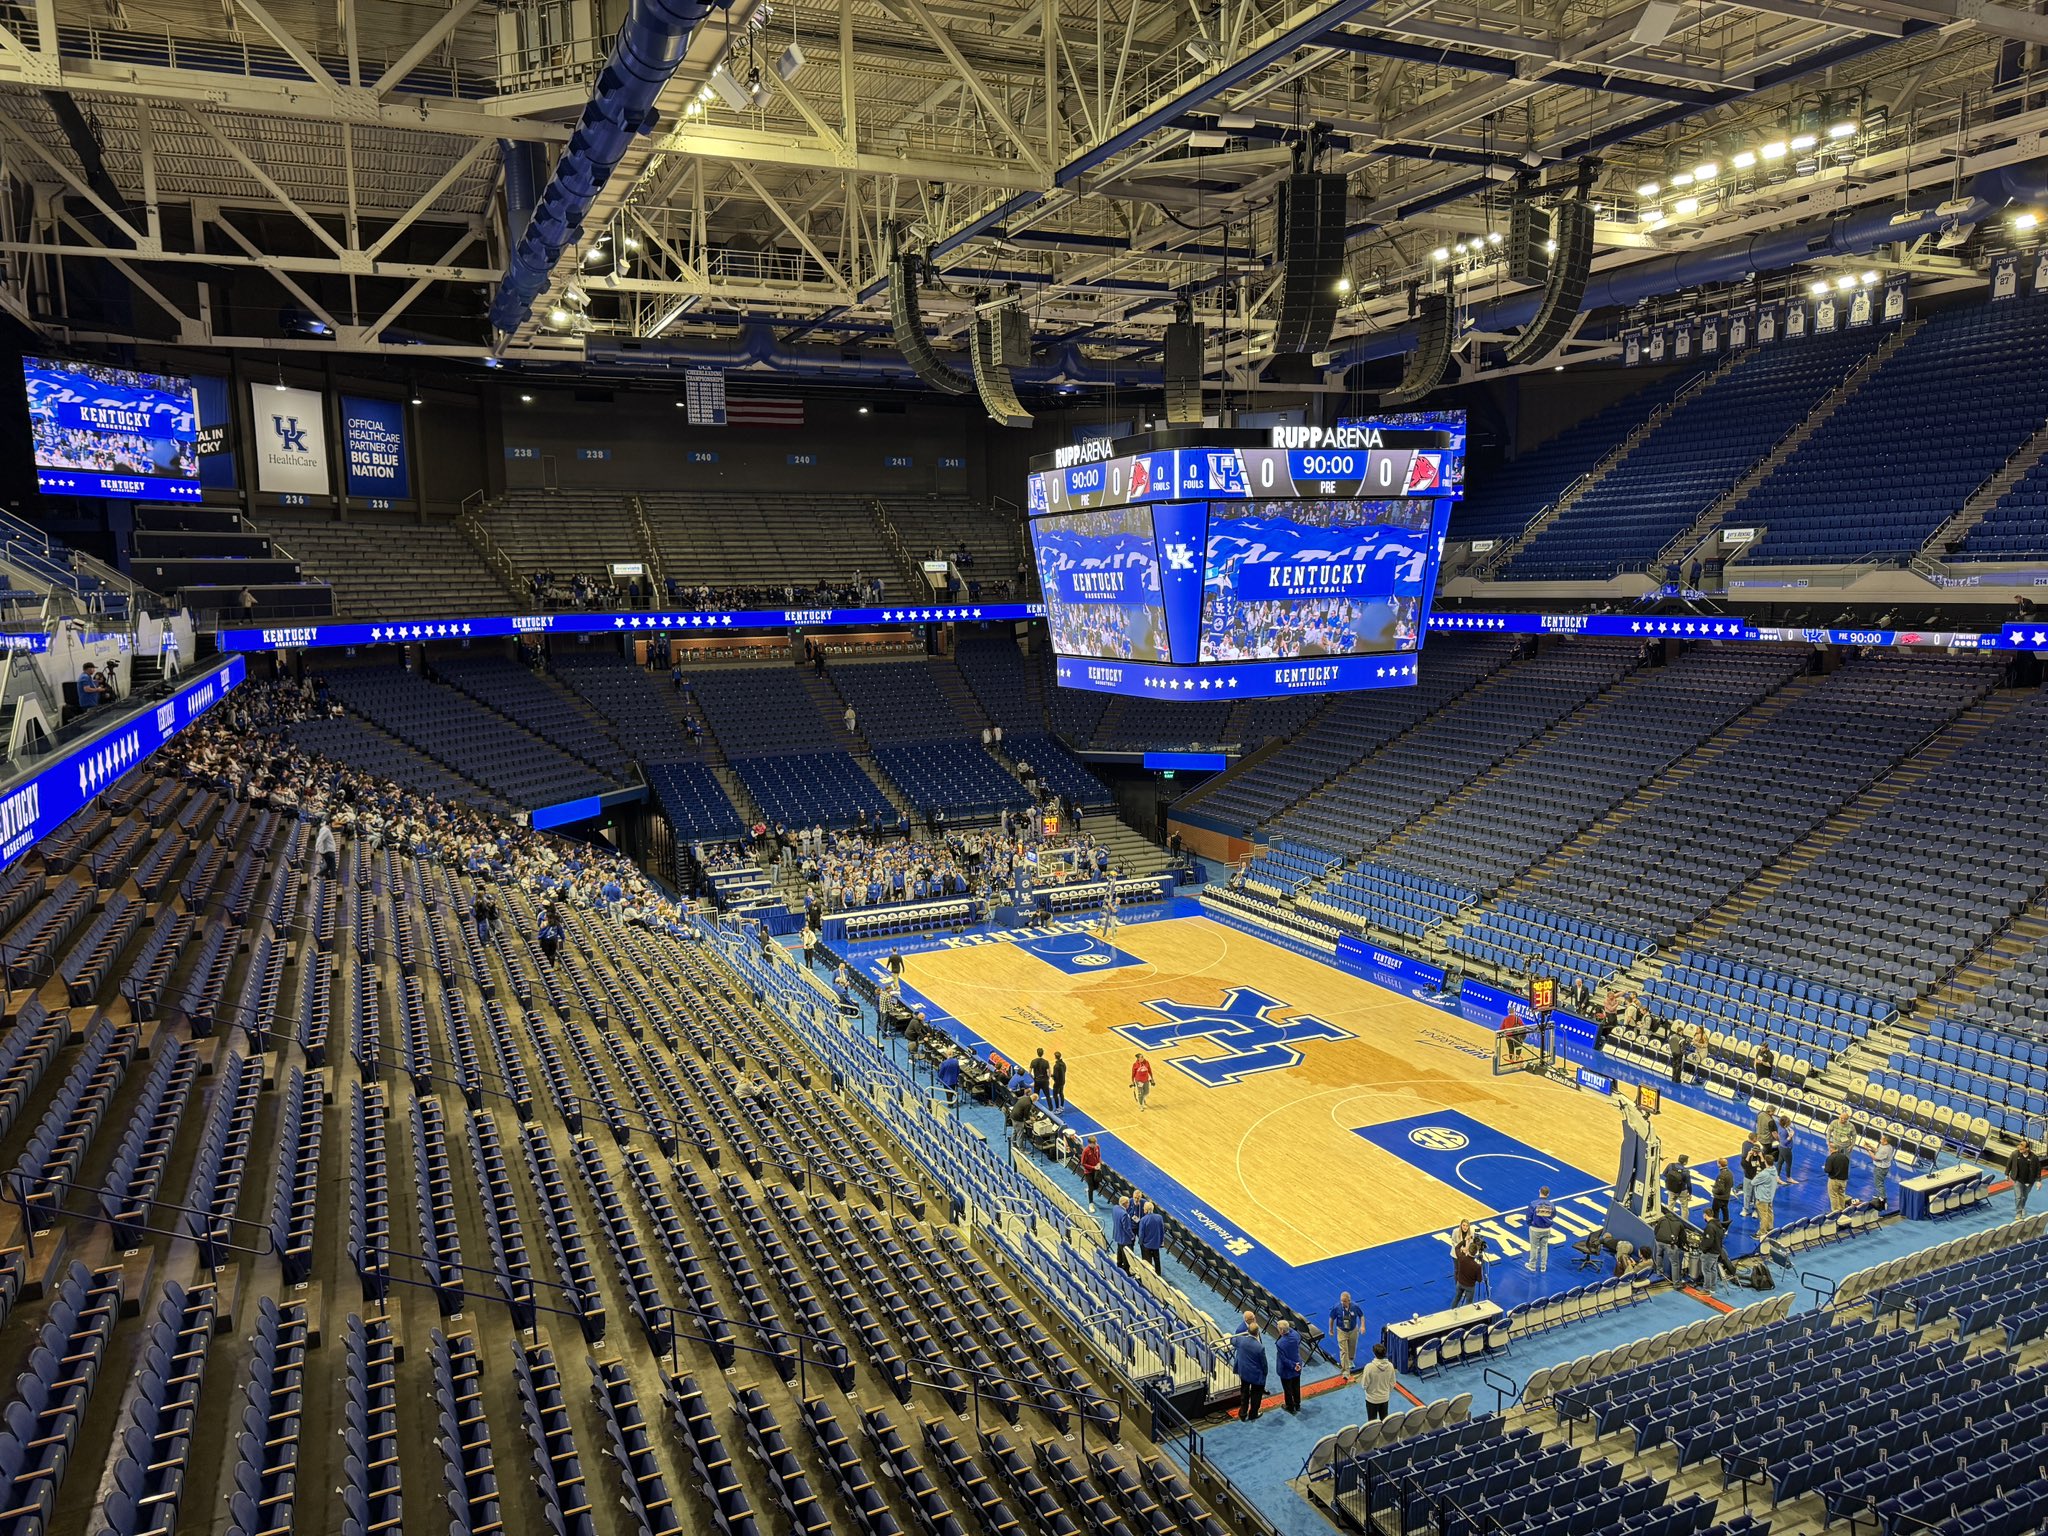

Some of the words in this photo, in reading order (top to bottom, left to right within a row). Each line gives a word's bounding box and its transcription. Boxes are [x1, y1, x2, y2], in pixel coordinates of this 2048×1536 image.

[1996, 256, 2018, 266] JONES
[2000, 277, 2009, 285] 27
[80, 406, 151, 428] KENTUCKY
[97, 423, 139, 432] BASKETBALL
[348, 418, 385, 431] OFFICIAL
[212, 429, 224, 440] IN
[272, 414, 309, 453] UK
[350, 430, 400, 443] HEALTHCARE
[1273, 426, 1323, 448] RUPP
[1322, 427, 1384, 448] ARENA
[350, 440, 386, 452] PARTNER
[387, 444, 399, 453] OF
[514, 448, 532, 457] 238
[351, 452, 370, 464] BIG
[372, 454, 399, 466] BLUE
[586, 450, 604, 459] 238
[695, 453, 712, 461] 240
[795, 456, 810, 464] 240
[1055, 445, 1080, 468] RUPP
[1080, 439, 1113, 463] ARENA
[269, 454, 318, 467] HealthCare
[892, 458, 906, 466] 241
[945, 459, 959, 467] 241
[1303, 455, 1354, 474] 90:00
[352, 465, 395, 478] NATION
[1157, 466, 1164, 480] 0
[1190, 464, 1197, 479] 0
[1261, 458, 1274, 488] 0
[1379, 458, 1392, 487] 0
[100, 479, 145, 490] KENTUCKY
[1072, 468, 1099, 489] 90:00
[1112, 467, 1120, 496] 0
[1183, 480, 1204, 489] FOULS
[1052, 477, 1059, 504] 0
[1153, 481, 1170, 491] FOULS
[1320, 481, 1336, 494] PRE
[286, 495, 304, 504] 236
[372, 500, 389, 509] 236
[1081, 494, 1090, 506] PRE
[1165, 543, 1194, 570] UK
[1072, 571, 1125, 592] KENTUCKY
[1269, 564, 1366, 587] KENTUCKY
[1288, 586, 1346, 595] BASKETBALL
[784, 610, 833, 621] KENTUCKY
[512, 617, 554, 628] KENTUCKY
[1541, 616, 1588, 630] KENTUCKY
[263, 628, 318, 643] KENTUCKY
[1788, 630, 1793, 640] 0
[1850, 632, 1882, 644] 90:00
[1934, 634, 1940, 645] 0
[1088, 666, 1123, 683] KENTUCKY
[1275, 666, 1340, 684] KENTUCKY
[1288, 680, 1327, 688] BASKETBALL
[157, 701, 175, 732] KENTUCKY
[0, 782, 40, 846] NTUCKY
[1044, 824, 1057, 834] 30
[3, 828, 34, 861] BASKETBALL
[939, 918, 1126, 949] KENTUCK
[1373, 952, 1402, 969] KENTUCKY
[1534, 980, 1552, 991] 90:00
[1536, 990, 1552, 1007] 30
[1454, 1046, 1491, 1060] RUPP
[1582, 1070, 1606, 1088] KENTUCKY
[1411, 1128, 1466, 1150] SEC
[1190, 1209, 1232, 1240] HealthCare
[1224, 1237, 1255, 1257] UK
